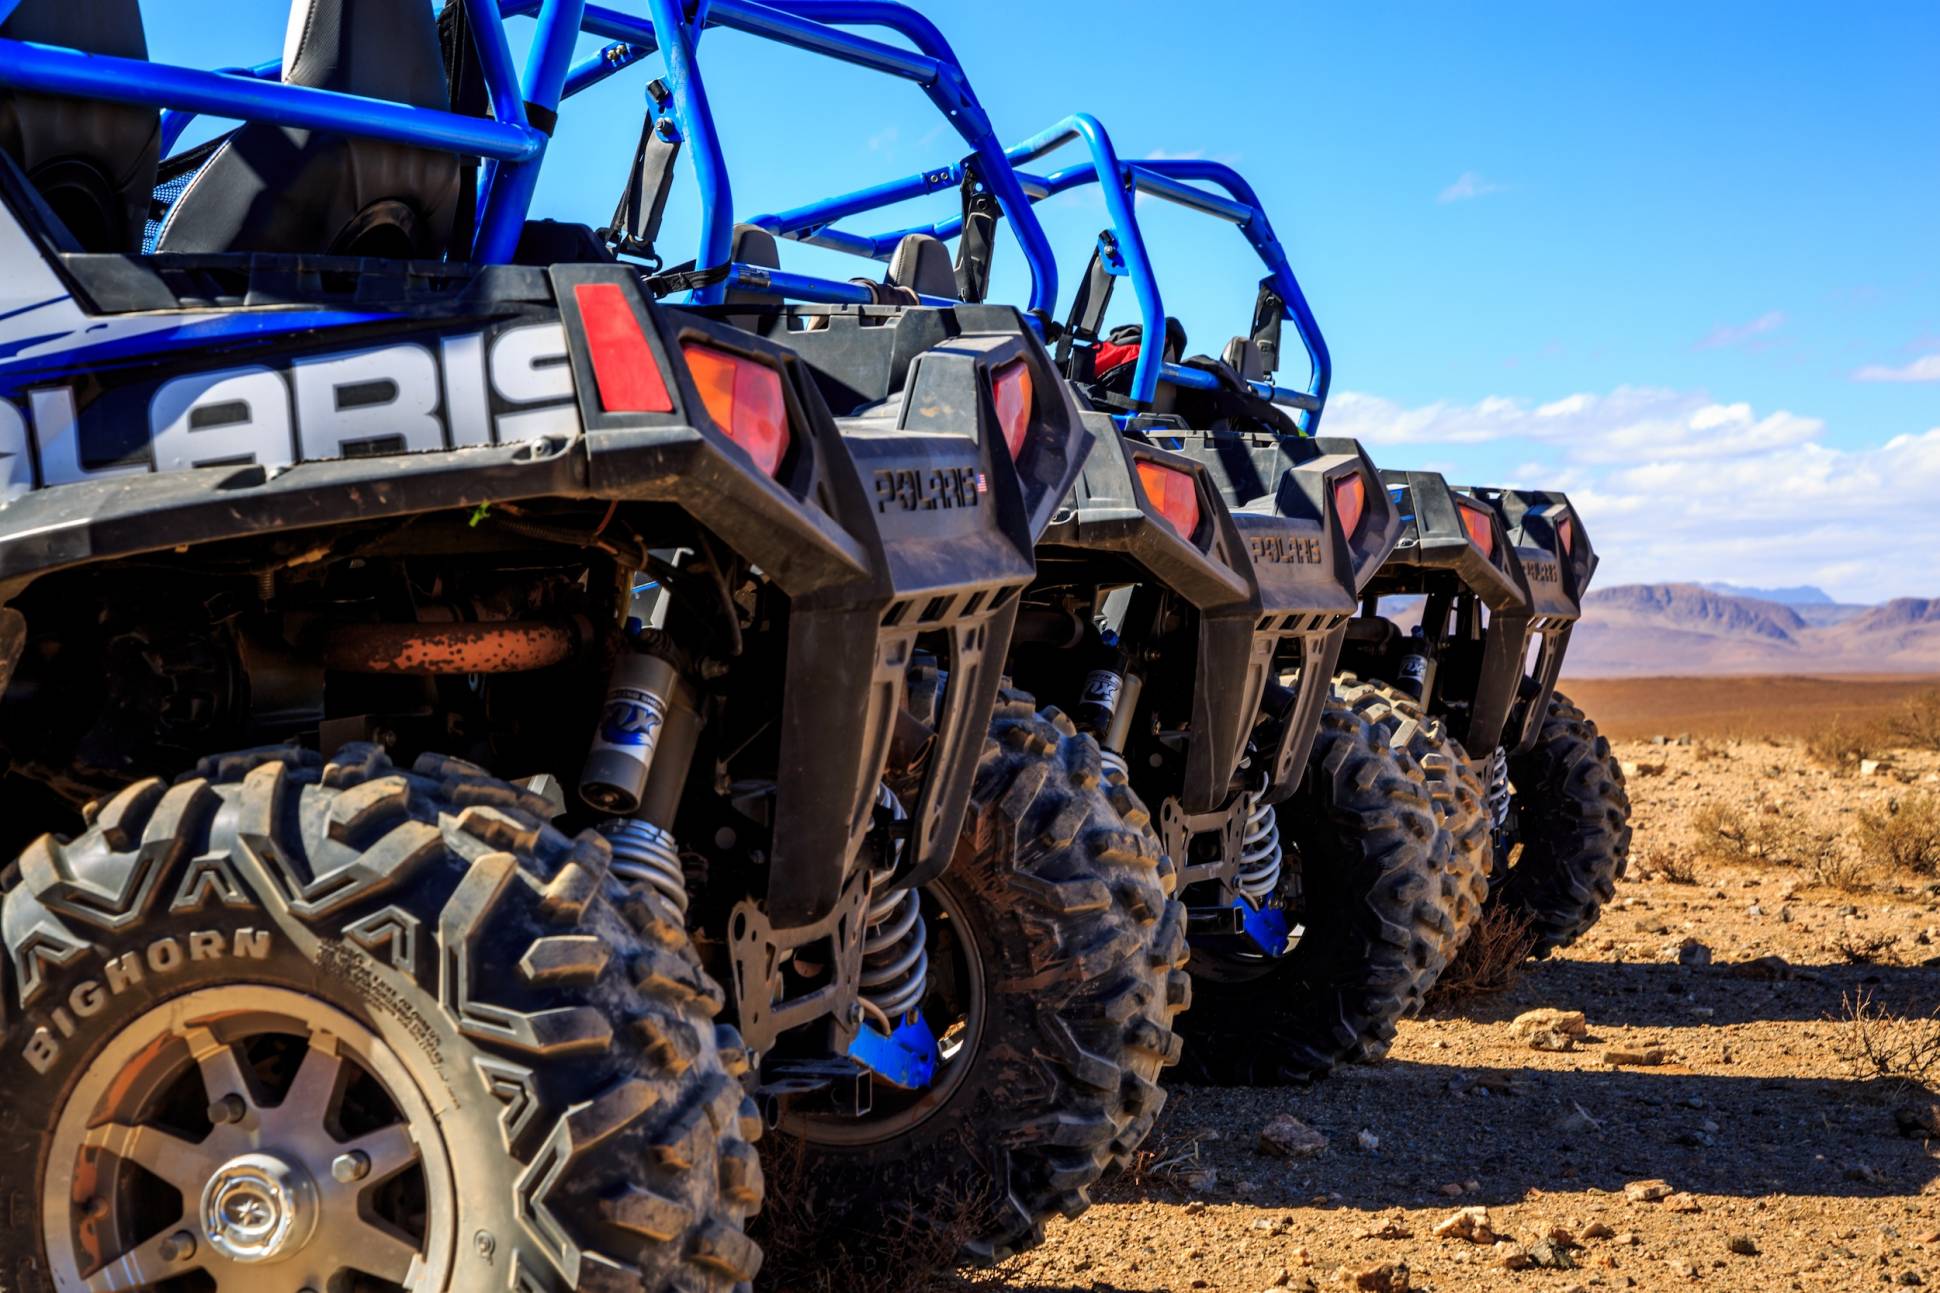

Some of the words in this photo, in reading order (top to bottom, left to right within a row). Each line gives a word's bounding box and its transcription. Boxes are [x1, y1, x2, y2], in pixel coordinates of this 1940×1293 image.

[0, 323, 580, 500] LARIS
[873, 465, 979, 513] POLARIS
[1249, 536, 1322, 564] POLARIS
[21, 927, 272, 1076] BIGHORN
